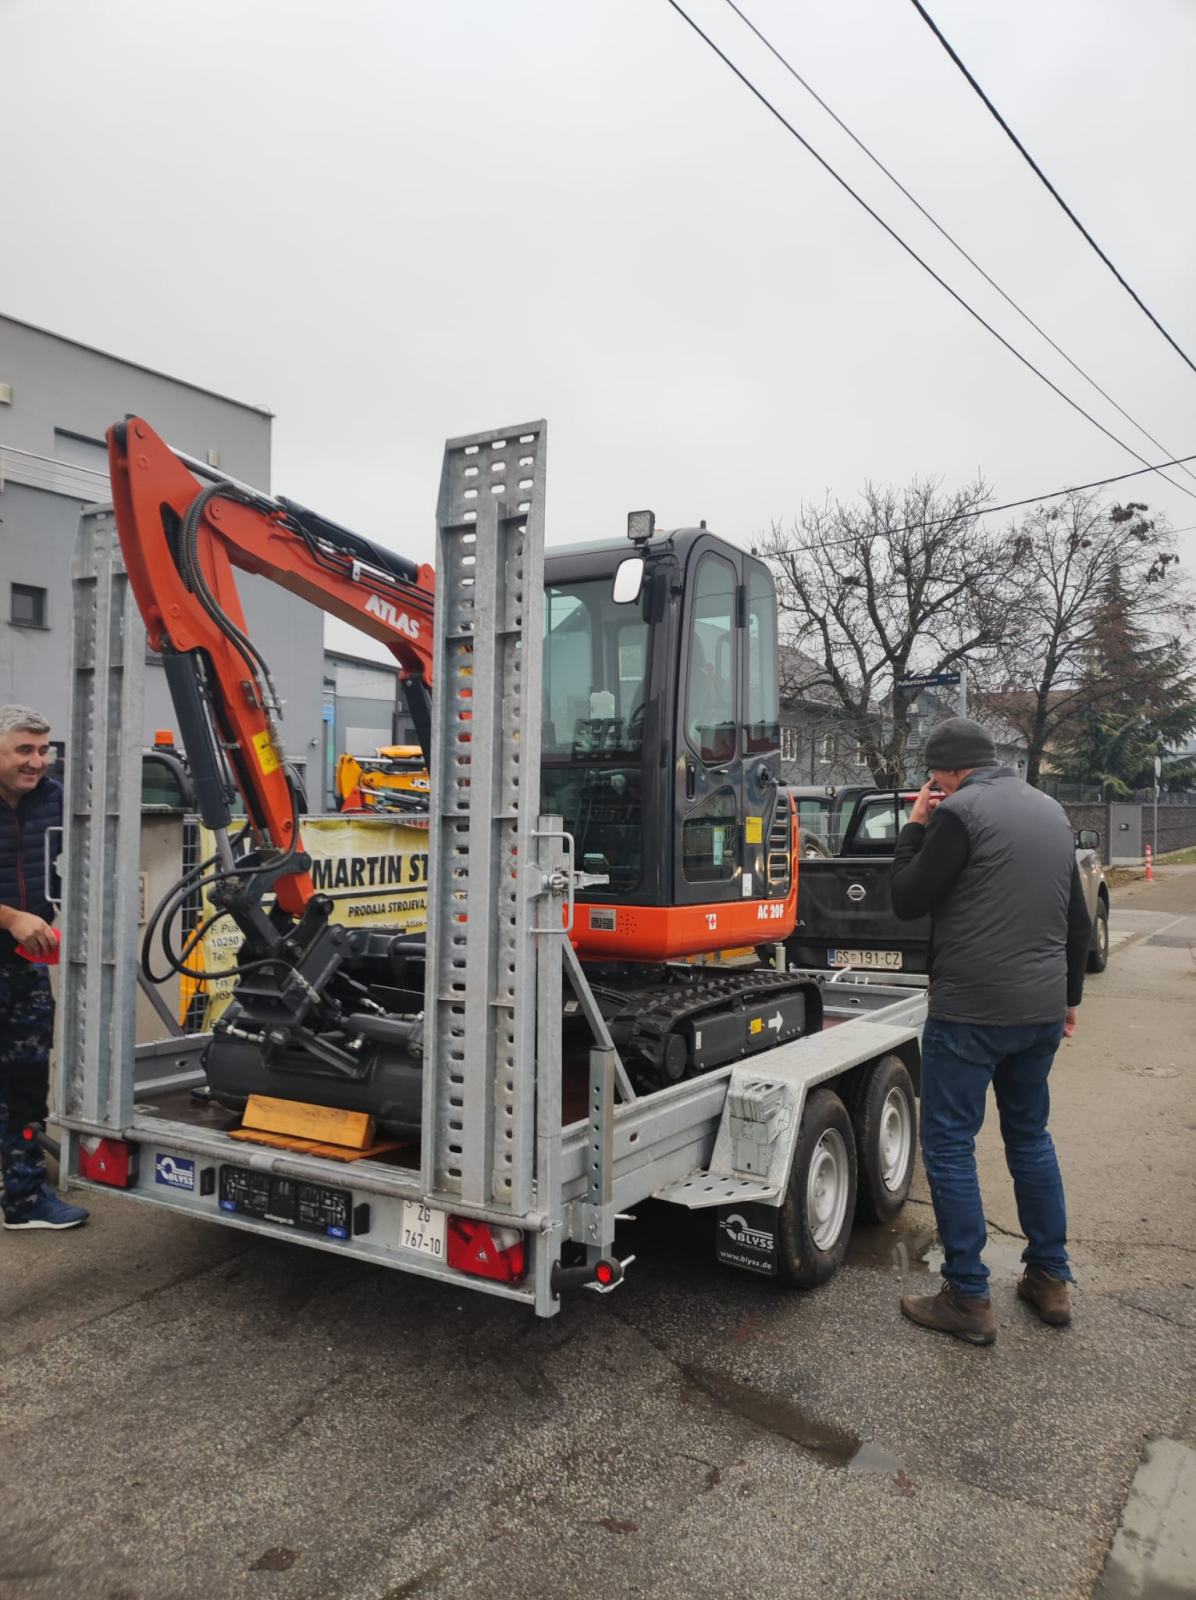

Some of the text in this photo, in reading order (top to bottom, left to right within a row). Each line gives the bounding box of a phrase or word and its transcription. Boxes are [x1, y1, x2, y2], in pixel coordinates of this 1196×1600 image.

[364, 593, 420, 639] ATLAS
[312, 855, 402, 890] MARTIN
[348, 902, 386, 918] PRODAJA
[757, 904, 768, 919] AC
[211, 935, 239, 948] 10250
[836, 950, 900, 966] GS 191-CZ
[418, 1204, 430, 1222] ZG
[405, 1229, 441, 1255] 767-10
[737, 1232, 774, 1250] BLYSS
[720, 1250, 773, 1270] www.blyss.de
